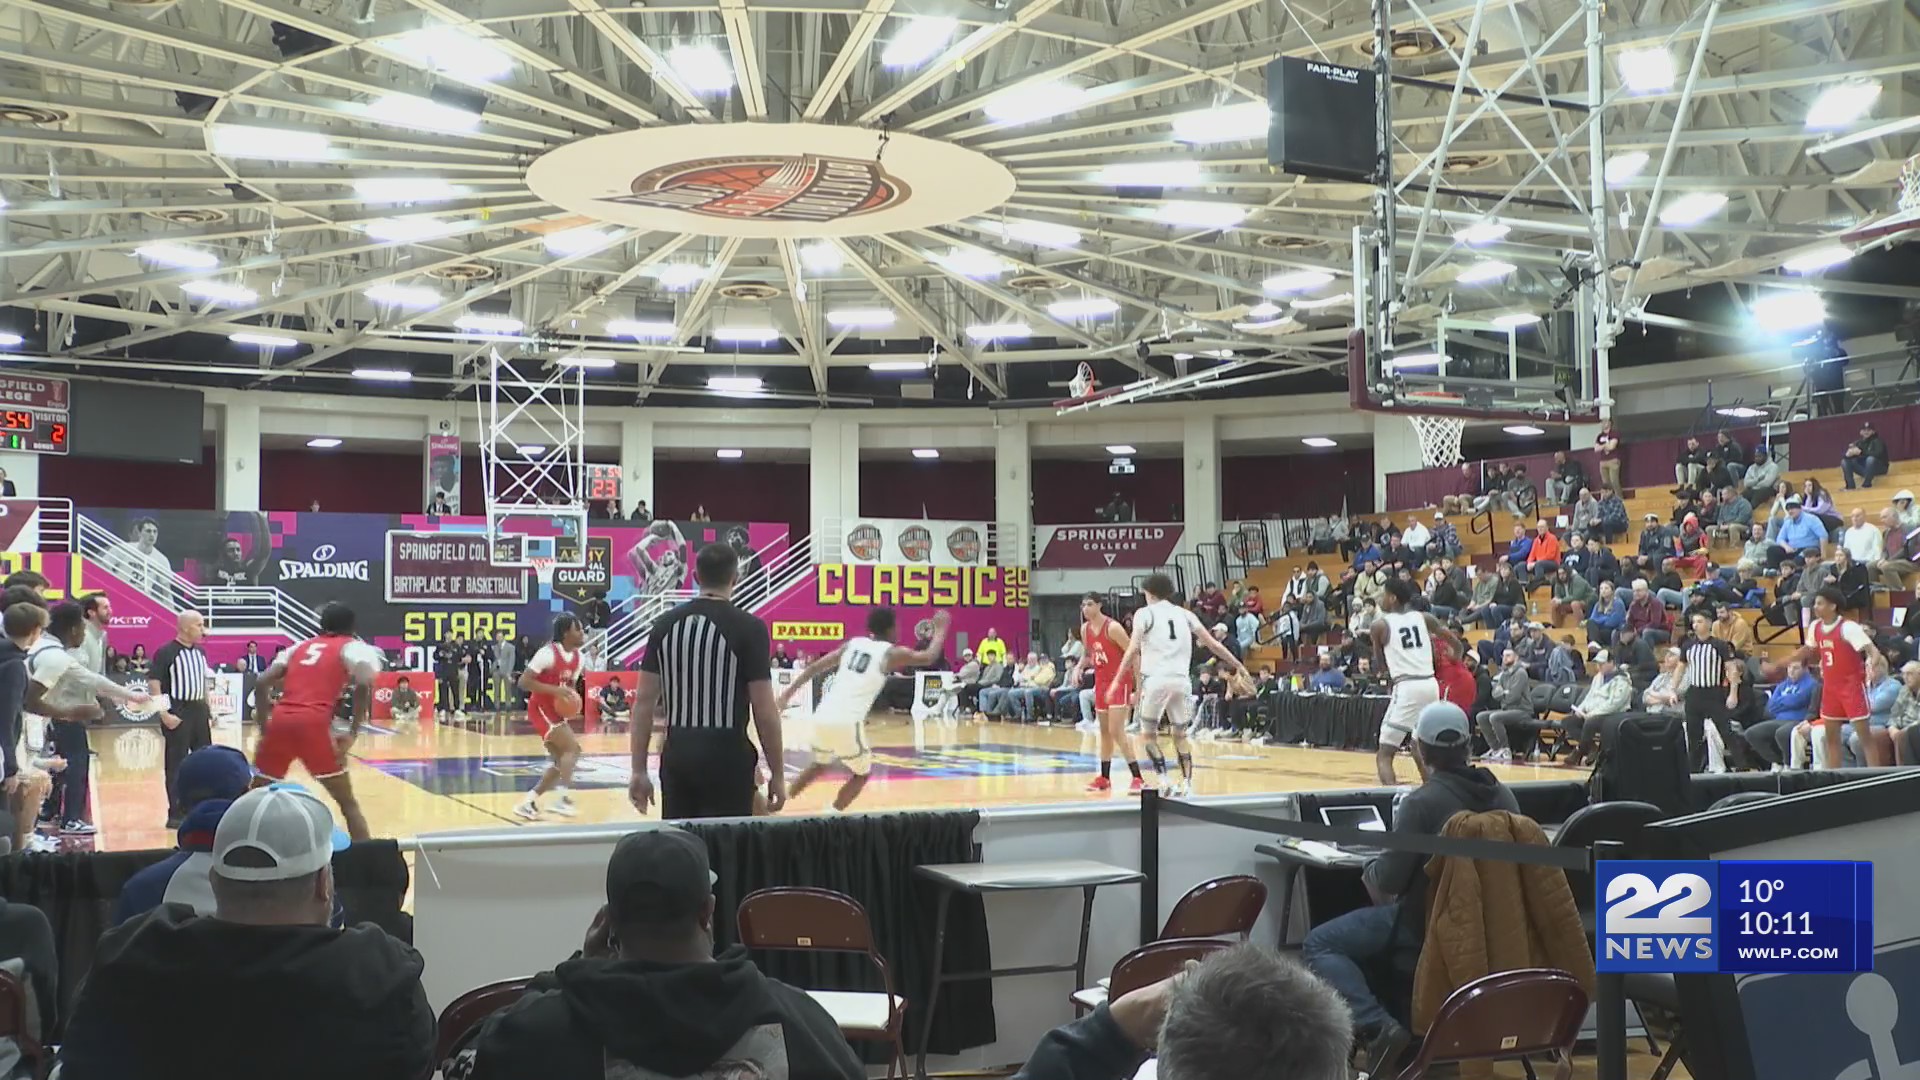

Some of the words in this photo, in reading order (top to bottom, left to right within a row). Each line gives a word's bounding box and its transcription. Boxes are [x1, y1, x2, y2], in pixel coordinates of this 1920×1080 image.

[1306, 62, 1359, 79] FAIR-PLAY
[35, 412, 67, 424] VISITOR
[52, 423, 65, 444] 2
[592, 479, 617, 498] 23
[1056, 527, 1164, 542] SPRINGFIELD
[399, 542, 465, 561] SPRINGFIELD
[1083, 542, 1137, 551] COLLEGE
[279, 559, 370, 581] SPALDING
[558, 569, 606, 583] GUARD
[1003, 566, 1029, 586] 20
[393, 574, 446, 594] BIRTHPLACE
[450, 577, 462, 593] OF
[466, 576, 519, 595] BASKETBALL
[818, 563, 997, 606] CLASSIC
[1003, 587, 1029, 608] 25
[404, 611, 516, 641] STARS
[776, 625, 841, 637] PANINI
[1168, 619, 1177, 640] 1
[1398, 625, 1424, 649] 21
[300, 643, 327, 666] 5
[847, 650, 871, 674] 10
[1823, 651, 1834, 667] 3
